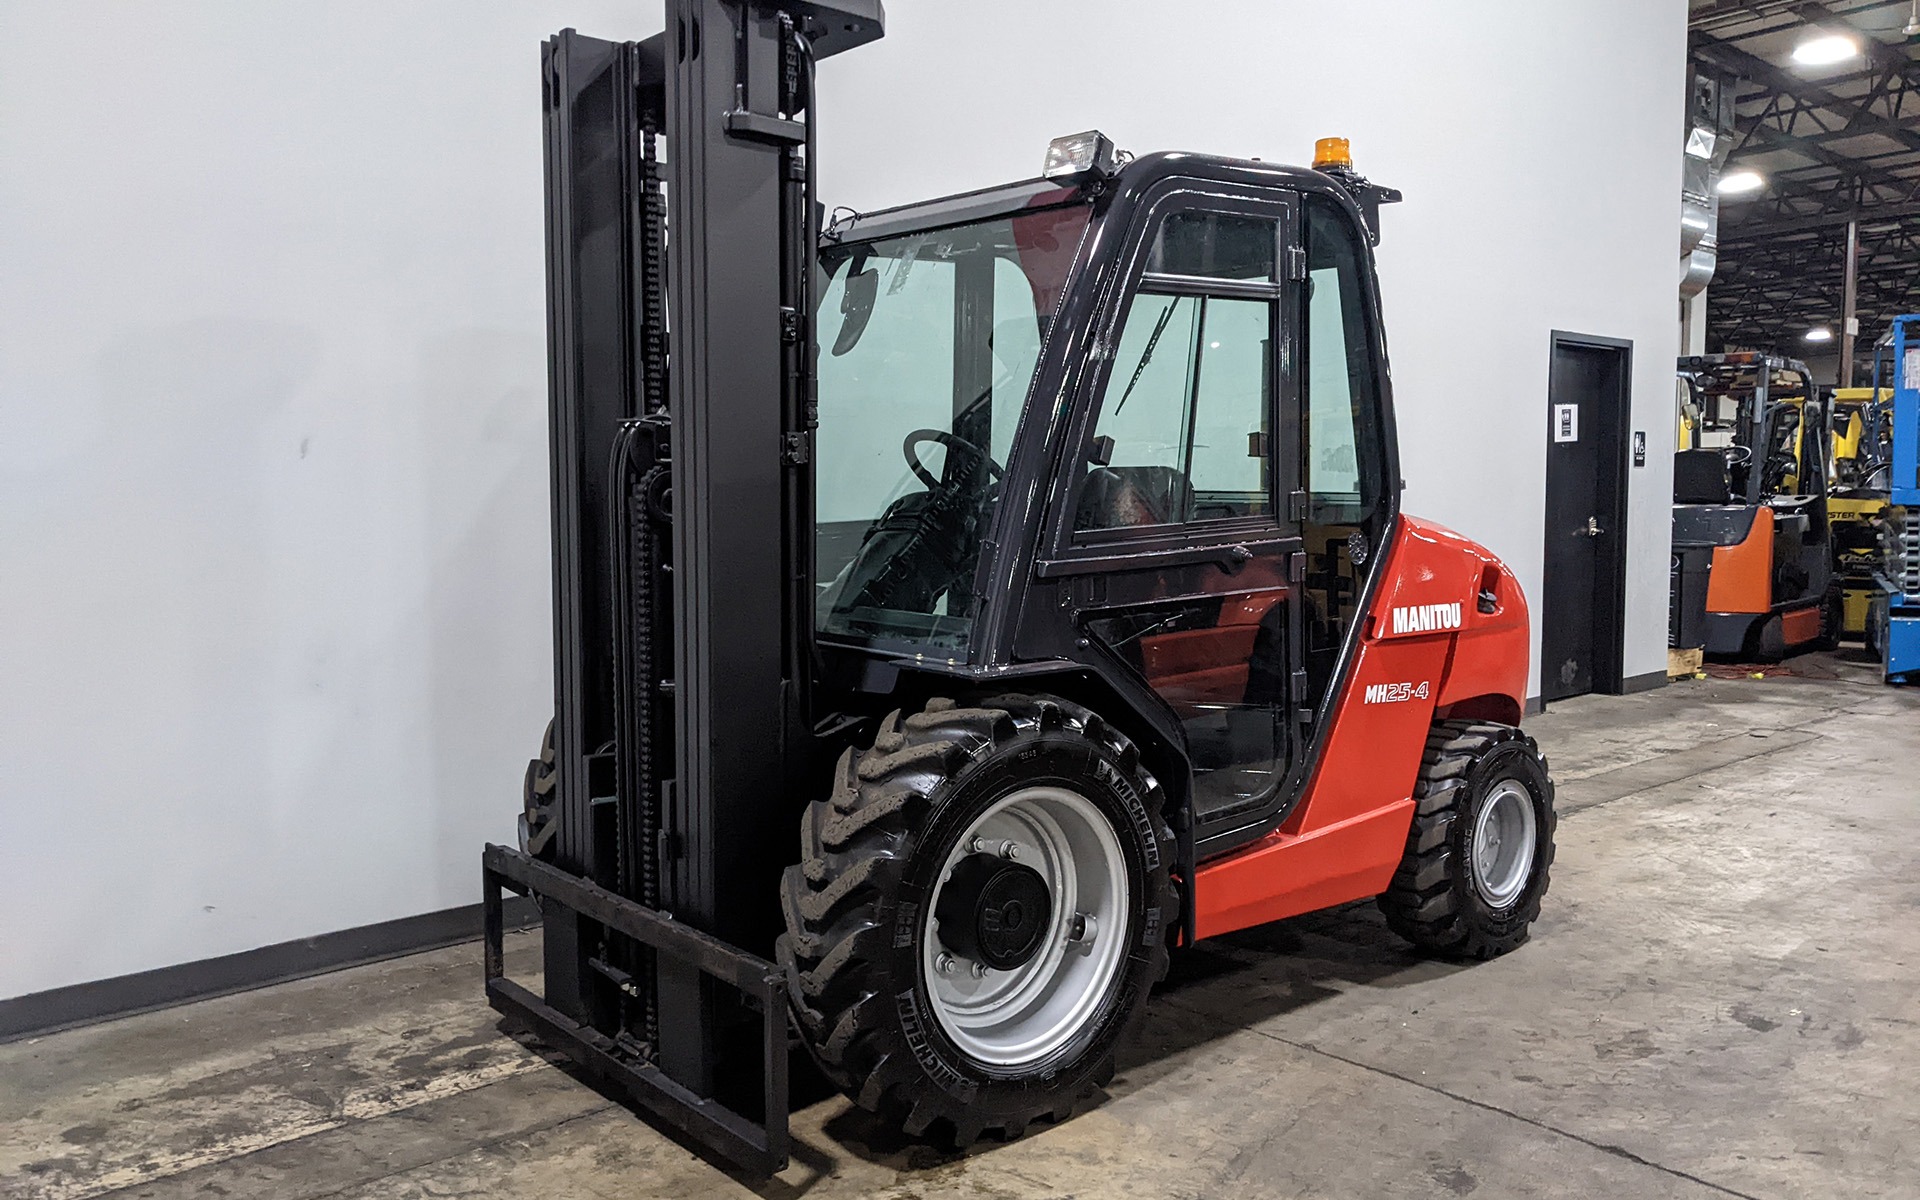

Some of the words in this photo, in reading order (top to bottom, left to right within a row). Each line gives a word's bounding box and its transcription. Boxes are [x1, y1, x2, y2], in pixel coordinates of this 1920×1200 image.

[1827, 511, 1856, 519] STER
[1393, 602, 1461, 634] MANITOU
[1364, 681, 1429, 704] MH25-4
[1112, 777, 1159, 866] MICHELIN
[897, 997, 958, 1091] MICHELIN
